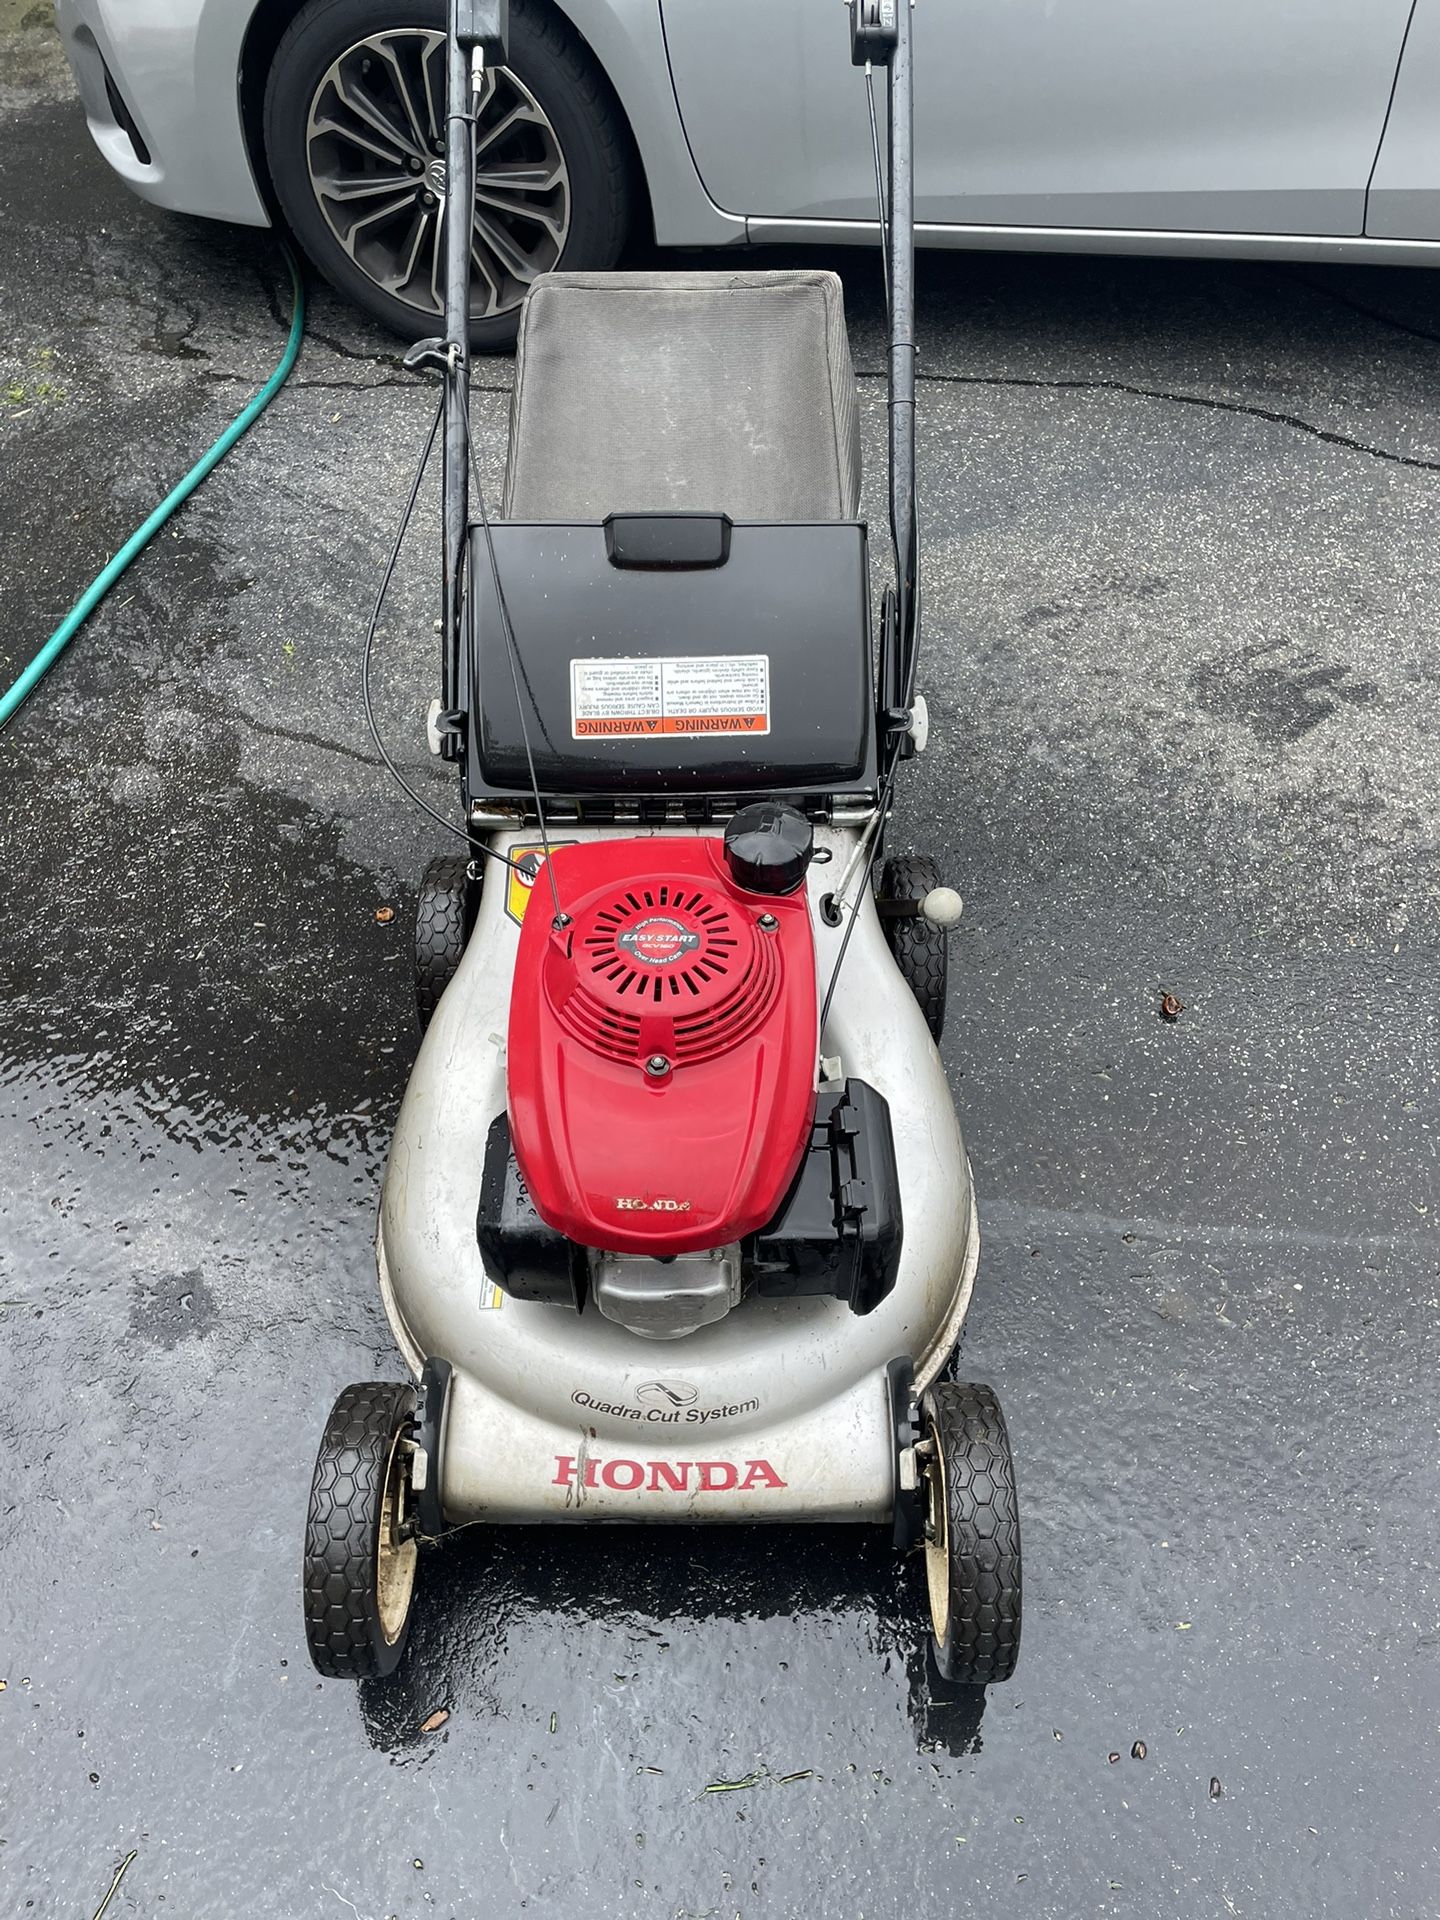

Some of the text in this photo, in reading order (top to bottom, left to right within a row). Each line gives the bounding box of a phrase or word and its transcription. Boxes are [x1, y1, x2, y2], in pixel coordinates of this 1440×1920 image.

[578, 721, 644, 733] WARNING
[675, 718, 741, 730] WARNING
[649, 918, 685, 931] Performance
[634, 951, 649, 961] Over
[668, 951, 682, 961] Cam
[575, 1392, 756, 1424] Quadra Cut System
[552, 1455, 788, 1491] HONDA
